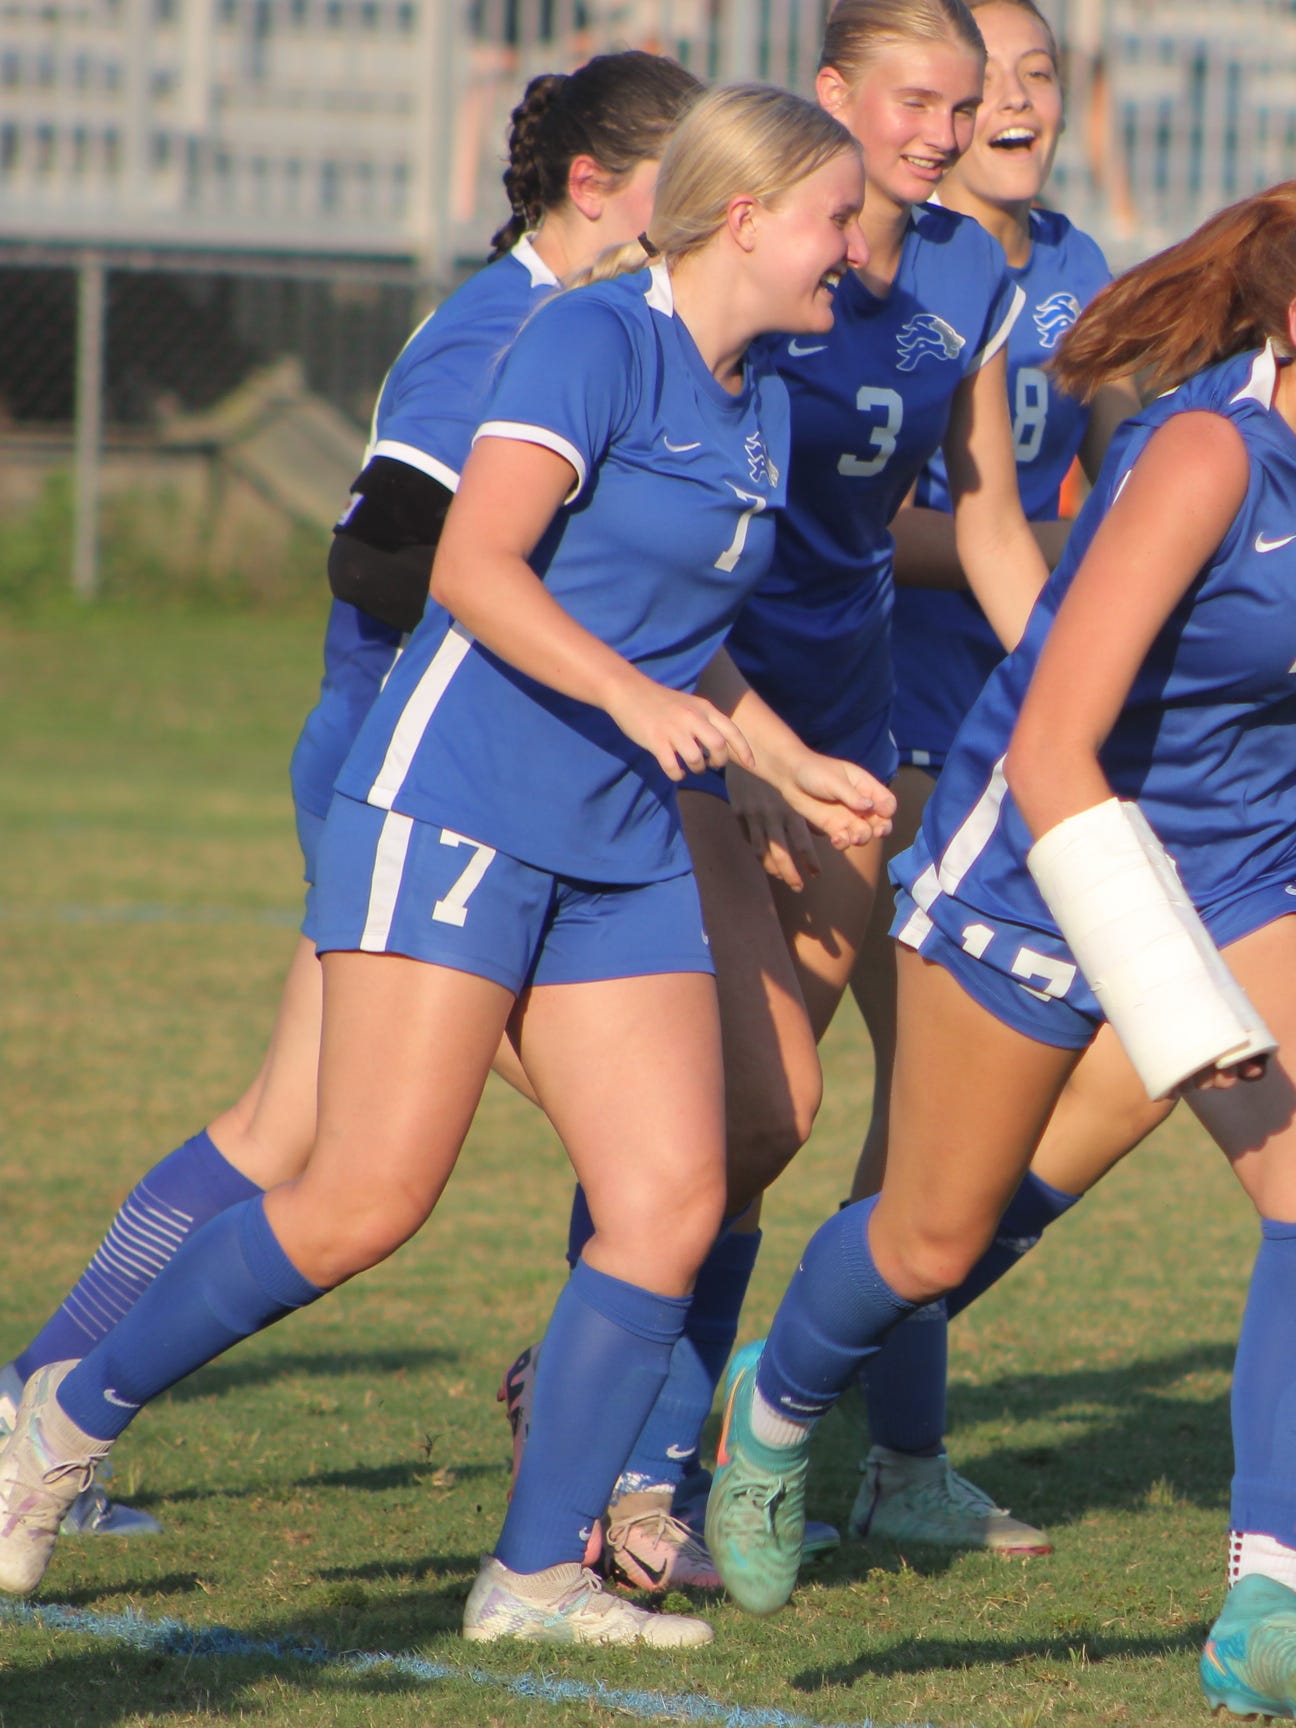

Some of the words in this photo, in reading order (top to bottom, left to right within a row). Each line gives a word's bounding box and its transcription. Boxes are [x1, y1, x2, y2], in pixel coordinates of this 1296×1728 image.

[837, 386, 903, 477] 3
[1014, 368, 1048, 462] 8
[714, 480, 767, 572] 7
[432, 828, 496, 928] 7
